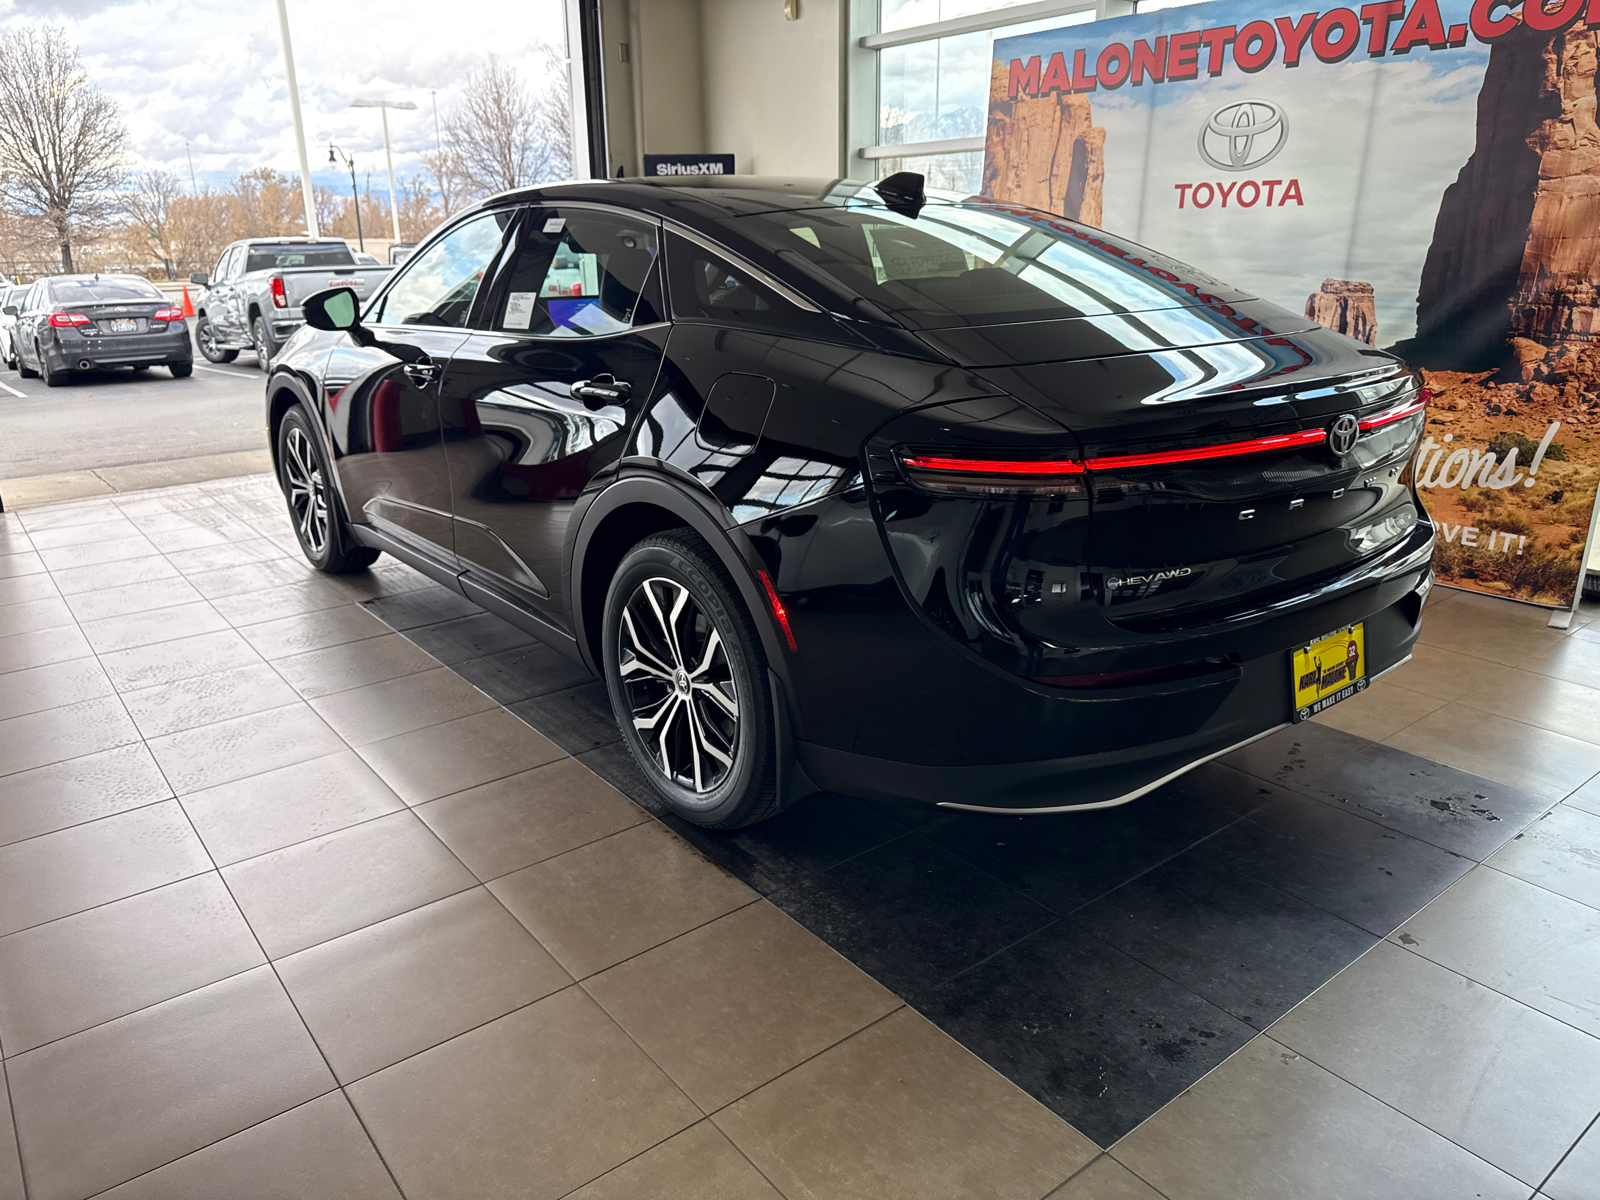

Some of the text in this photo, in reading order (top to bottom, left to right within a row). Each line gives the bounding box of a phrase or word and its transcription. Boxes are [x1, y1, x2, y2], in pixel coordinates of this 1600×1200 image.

[1008, 0, 1600, 100] MALONETOYOTA.CO
[656, 162, 724, 176] SiriusXM
[1174, 179, 1305, 209] TOYOTA
[1434, 521, 1526, 555] VE IT!
[1348, 645, 1356, 657] 32
[1313, 686, 1354, 713] WE MAKE IT EASY
